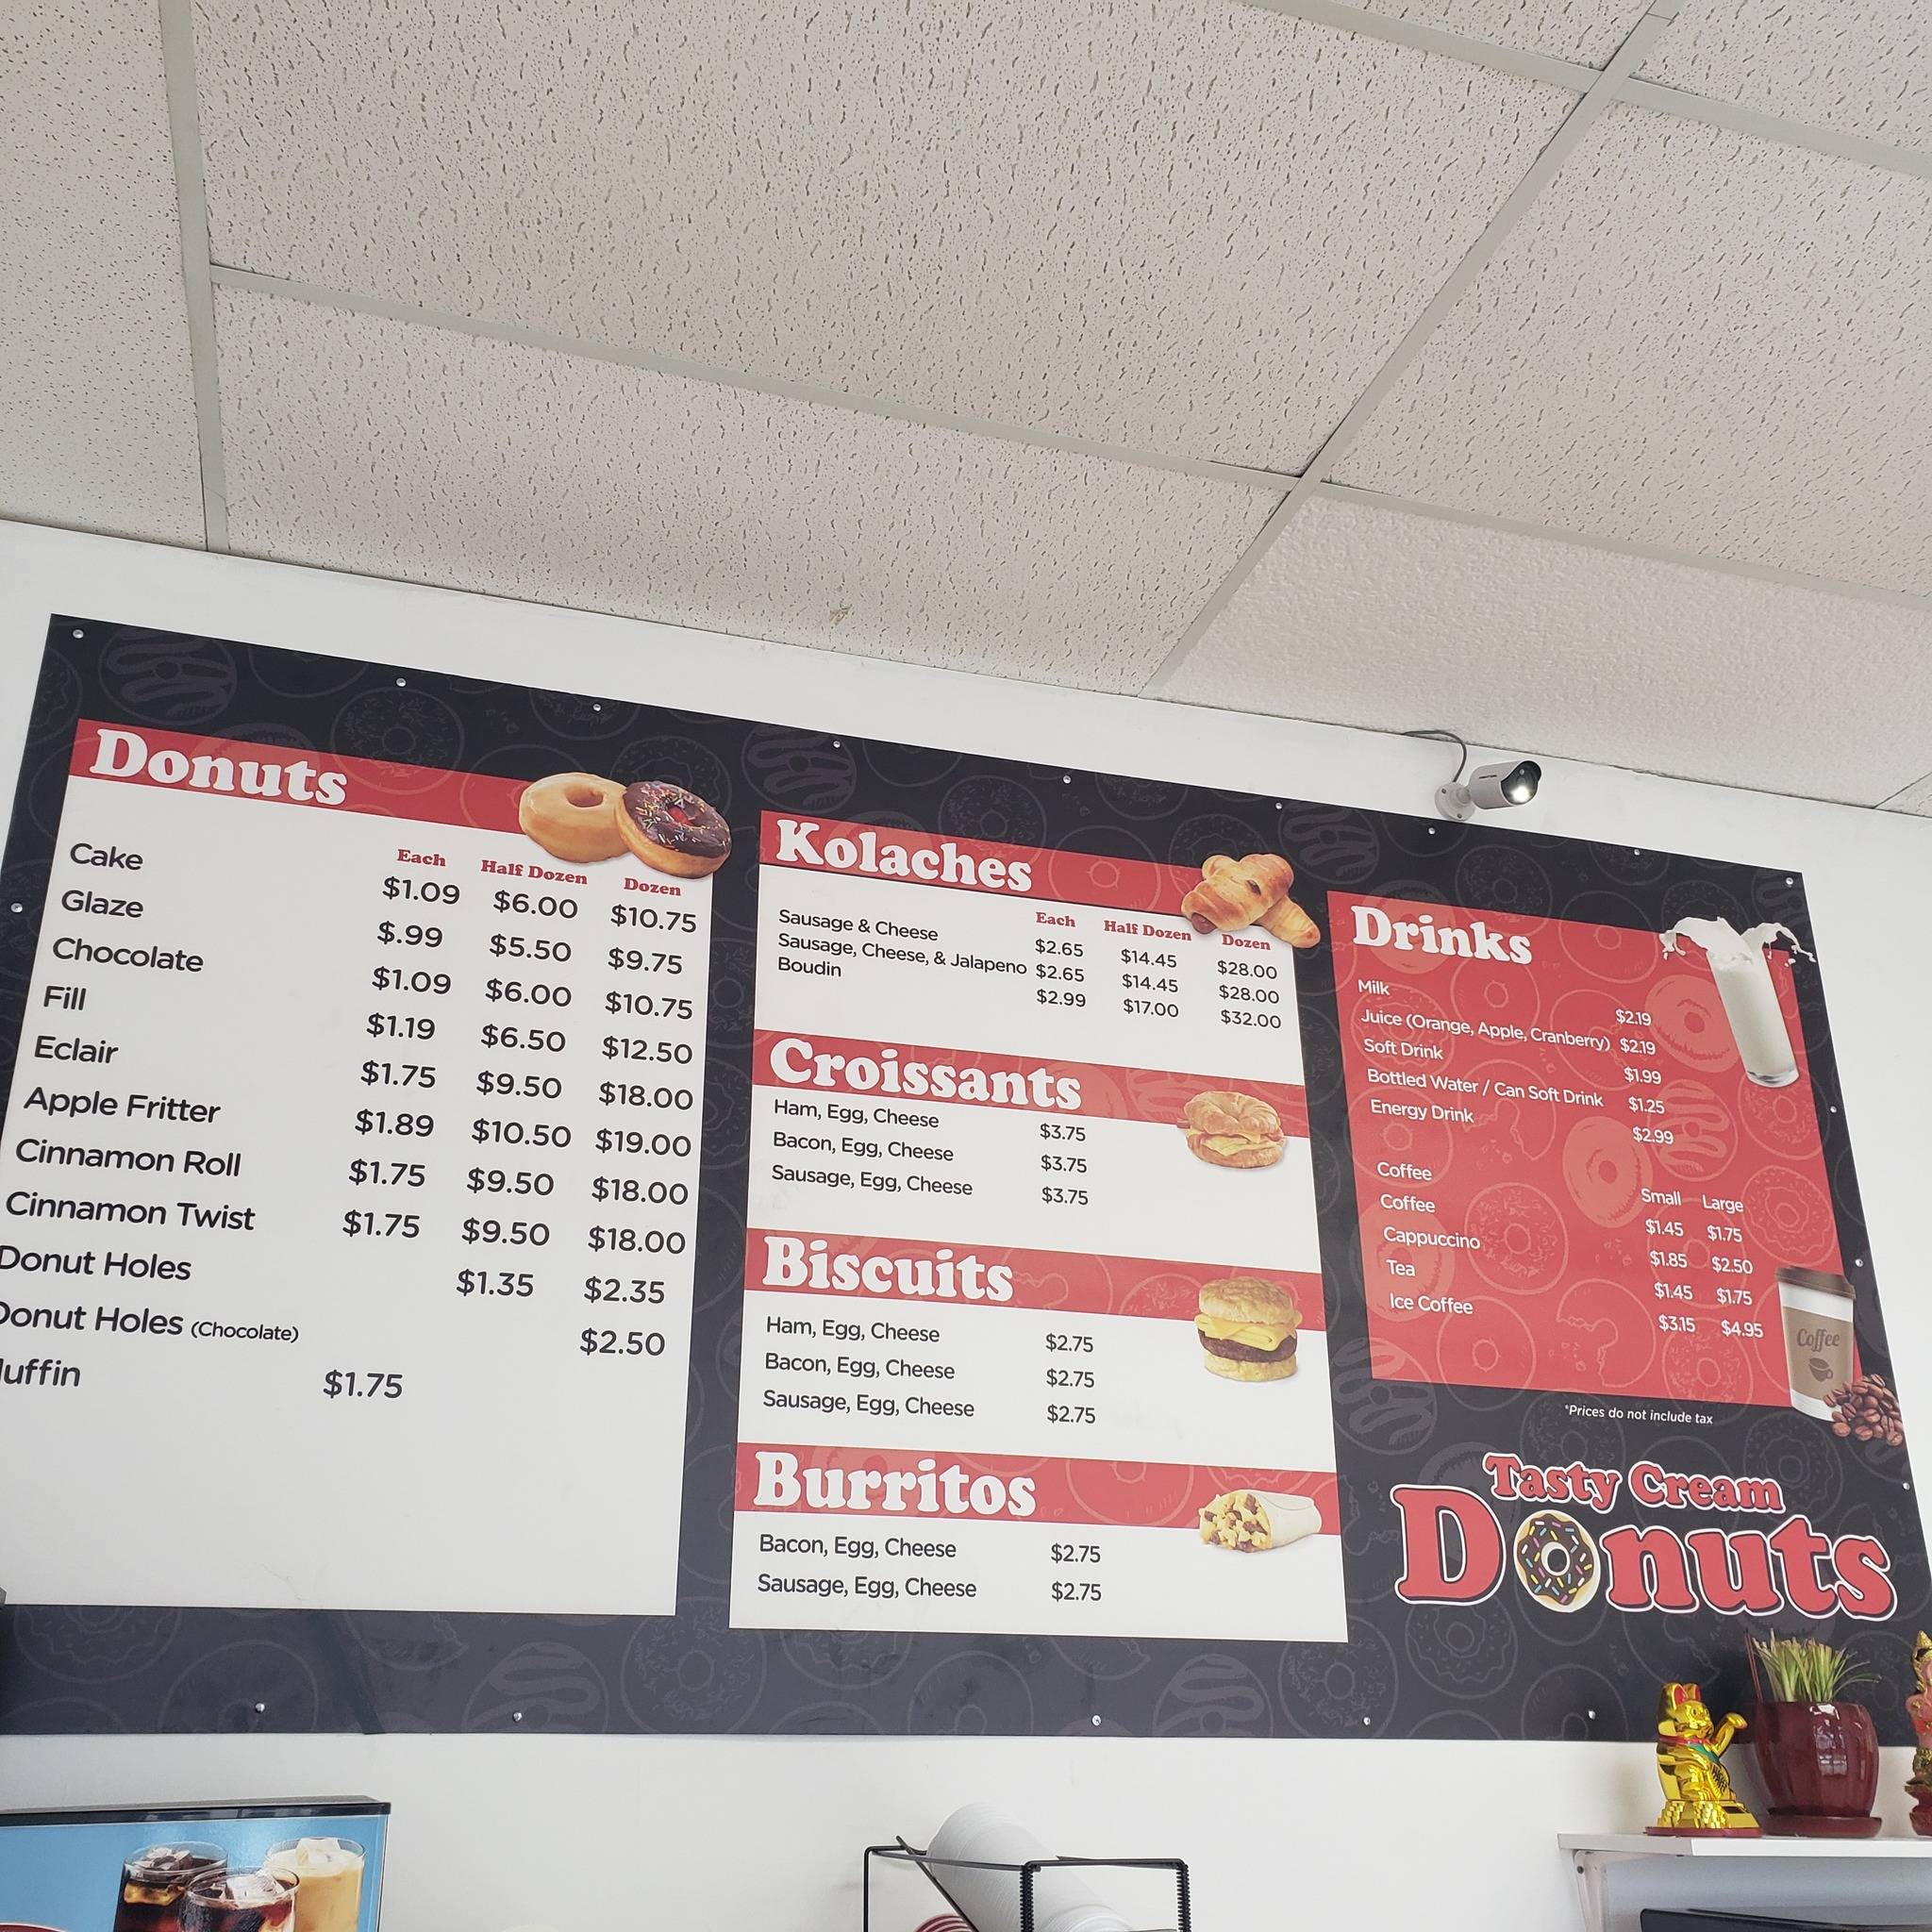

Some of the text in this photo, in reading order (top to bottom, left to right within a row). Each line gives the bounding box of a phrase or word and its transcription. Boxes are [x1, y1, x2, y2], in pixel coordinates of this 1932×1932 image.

[89, 726, 349, 808] Donuts
[71, 843, 142, 870] Cake
[398, 848, 445, 867] Each
[775, 819, 1033, 891] Kolaches
[482, 860, 587, 885] Half Dozen
[383, 876, 459, 904] $1.09
[624, 877, 680, 896] Dozen
[61, 891, 143, 918] Glaze
[493, 890, 577, 918] $6.00
[611, 905, 696, 932] $10.75
[779, 909, 938, 941] Sausage & Cheese
[1036, 911, 1075, 927] Each
[1104, 921, 1192, 941] Half Dozen
[377, 921, 442, 947] $.99
[1223, 934, 1270, 950] Dozen
[1351, 906, 1531, 964] Drinks
[53, 938, 203, 972] Chocolate
[490, 934, 571, 961] $5.50
[608, 947, 682, 974] $9.75
[778, 933, 1026, 974] Sausage, Cheese, & Jalapeno
[1036, 939, 1083, 957] $2.65
[1122, 949, 1176, 968] $14.45
[778, 957, 841, 976] Boudin
[1036, 964, 1084, 982] $2.65
[1218, 960, 1277, 979] $28.00
[372, 966, 451, 994] $1.09
[486, 978, 571, 1007] $6.00
[1123, 974, 1178, 992] $14.45
[1358, 980, 1390, 995] Milk
[43, 986, 86, 1010] Fill
[605, 991, 691, 1019] $10.75
[1037, 989, 1086, 1007] $2.99
[1220, 985, 1279, 1004] $28.00
[1124, 999, 1178, 1017] $17.00
[1222, 1009, 1281, 1028] $32.00
[1616, 1009, 1651, 1025] $2.19
[367, 1012, 435, 1040] $1.19
[481, 1024, 565, 1052] $6.50
[1361, 1009, 1610, 1051] Juice (Orange, Apple, Cranberry)
[35, 1036, 118, 1063] Eclair
[602, 1036, 692, 1064] $12.50
[1365, 1039, 1442, 1059] Soft Drink
[1621, 1038, 1656, 1055] $2.19
[361, 1060, 436, 1088] $1.75
[476, 1071, 561, 1098] $9.50
[769, 1039, 1083, 1110] Croissants
[1624, 1067, 1661, 1084] $1.99
[599, 1081, 692, 1109] $18.00
[1368, 1069, 1603, 1107] Bottled Water / Can Soft Drink
[24, 1087, 221, 1123] Apple Fritter
[775, 1099, 939, 1127] Ham, Egg, Cheese
[1372, 1100, 1474, 1123] Energy Drink
[1629, 1096, 1664, 1113] $1.25
[355, 1108, 433, 1137] $1.89
[472, 1118, 571, 1147] $10.50
[1041, 1124, 1085, 1141] $3.75
[1633, 1126, 1673, 1144] $2.99
[595, 1128, 691, 1157] $19.00
[774, 1132, 954, 1161] Bacon, Egg, Cheese
[16, 1139, 241, 1176] Cinnamon Roll
[1041, 1155, 1087, 1173] $3.75
[349, 1158, 425, 1187] $1.75
[467, 1167, 554, 1195] $9.50
[772, 1165, 973, 1195] Sausage, Egg, Cheese
[1377, 1162, 1431, 1180] Coffee
[591, 1176, 688, 1205] $18.00
[1042, 1187, 1088, 1205] $3.75
[1381, 1194, 1435, 1212] Coffee
[1641, 1189, 1681, 1205] Small
[7, 1191, 256, 1230] Cinnamon Twist
[1703, 1195, 1743, 1213] Large
[342, 1209, 420, 1238] $1.75
[462, 1218, 549, 1245] $9.50
[1646, 1219, 1683, 1236] $1.45
[1707, 1225, 1742, 1241] $1.75
[588, 1225, 685, 1254] $18.00
[1384, 1226, 1480, 1249] Cappuccino
[0, 1245, 191, 1280] Donut Holes
[761, 1235, 1015, 1304] Biscuits
[1387, 1259, 1415, 1275] Tea
[1650, 1251, 1687, 1267] $1.85
[1712, 1257, 1753, 1274] $2.50
[457, 1269, 533, 1296] $1.35
[584, 1276, 664, 1304] $2.35
[1655, 1282, 1692, 1299] $1.45
[1391, 1293, 1473, 1314] Ice Coffee
[1717, 1288, 1752, 1305] $1.75
[95, 1307, 183, 1335] Holes
[192, 1322, 298, 1343] (Chocolate)
[767, 1316, 940, 1342] Ham, Egg, Cheese
[1659, 1314, 1695, 1332] $3.15
[1722, 1320, 1763, 1338] $4.95
[580, 1328, 665, 1356] $2.50
[1046, 1333, 1093, 1352] $2.75
[1796, 1328, 1840, 1352] Coffee
[0, 1358, 80, 1387] uffin
[766, 1353, 955, 1379] Bacon, Egg, Cheese
[1046, 1369, 1094, 1388] $2.75
[324, 1370, 402, 1398] $1.75
[763, 1390, 974, 1417] Sausage, Egg, Cheese
[1047, 1404, 1095, 1424] $2.75
[1608, 1407, 1623, 1418] do
[1627, 1410, 1646, 1420] not
[1651, 1411, 1691, 1423] include
[1696, 1414, 1712, 1424] tax
[753, 1450, 1038, 1518] Burritos
[1482, 1452, 1786, 1514] Tasty Cream
[760, 1534, 956, 1558] Bacon, Egg, Cheese
[1051, 1543, 1100, 1563] $2.75
[758, 1574, 976, 1598] Sausage, Egg, Cheese
[1052, 1581, 1101, 1602] $2.75
